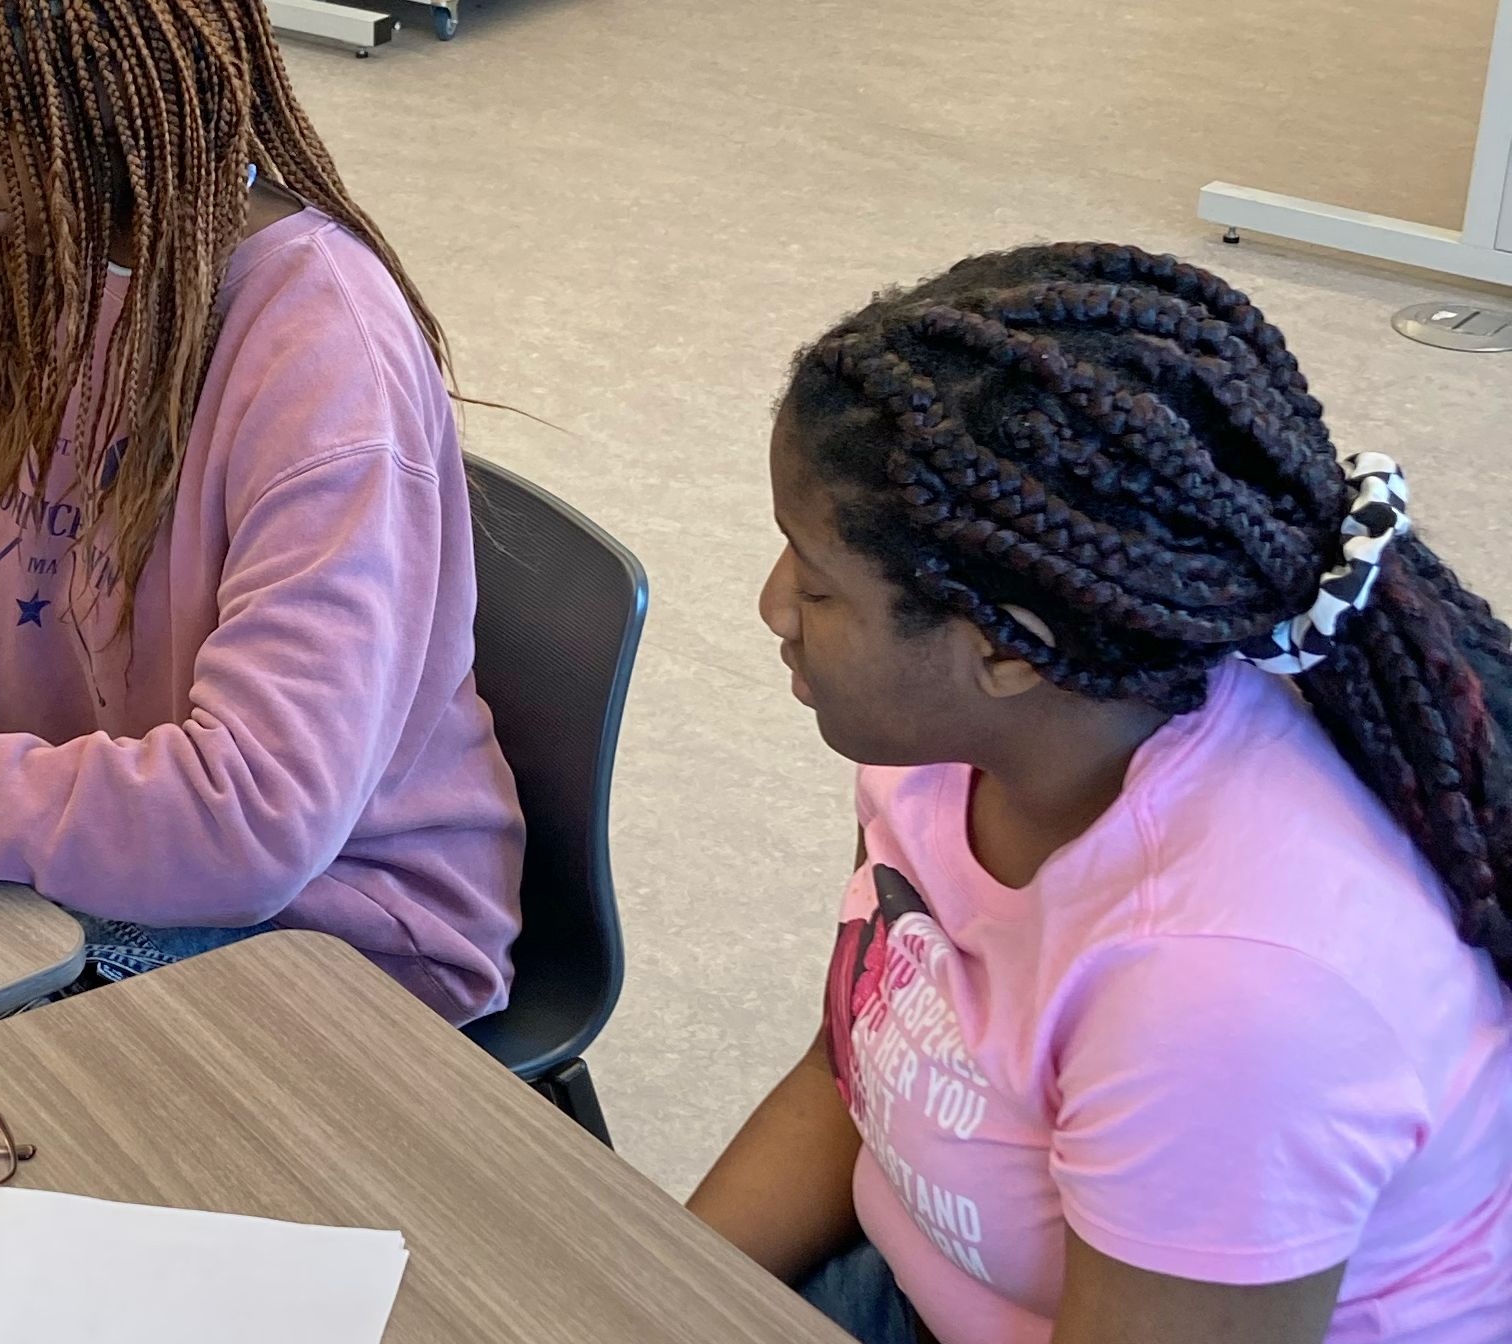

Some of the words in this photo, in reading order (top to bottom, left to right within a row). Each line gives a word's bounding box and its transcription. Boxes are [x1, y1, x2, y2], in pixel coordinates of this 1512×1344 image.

[27, 557, 57, 575] MA
[874, 1021, 920, 1101] HER
[923, 1064, 987, 1140] YOU
